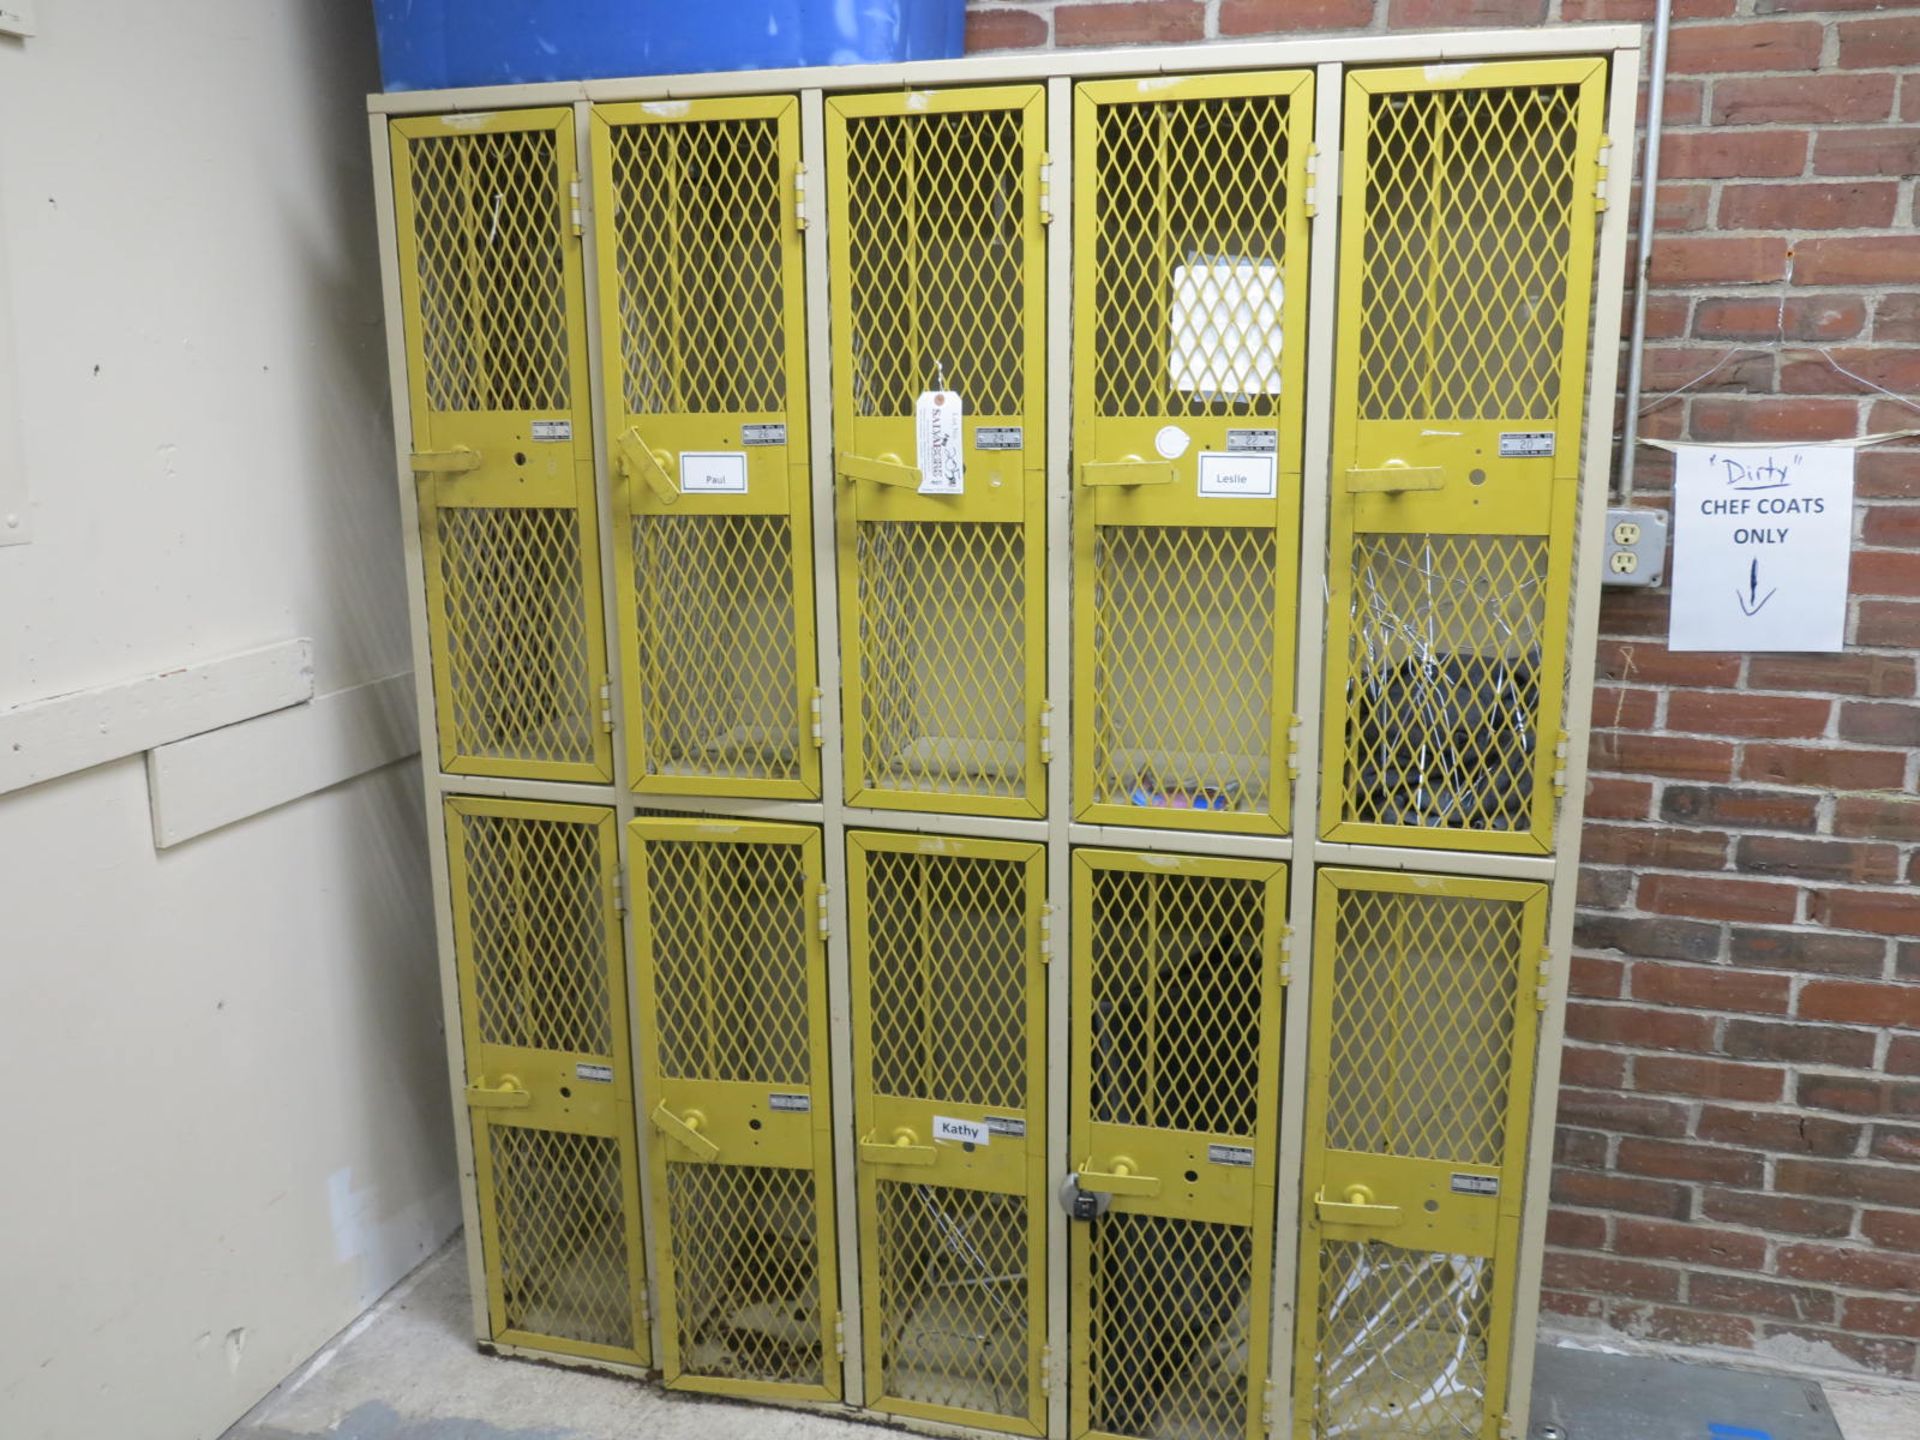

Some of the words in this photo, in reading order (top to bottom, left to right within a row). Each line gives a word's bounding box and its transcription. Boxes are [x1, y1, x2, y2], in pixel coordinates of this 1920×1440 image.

[1519, 438, 1534, 450] 20
[706, 475, 726, 485] Paul
[1216, 474, 1247, 484] Leslie
[1701, 498, 1750, 516] CHEF
[1756, 497, 1825, 515] COATS
[1733, 528, 1789, 544] ONLY
[942, 1122, 979, 1138] Kathy
